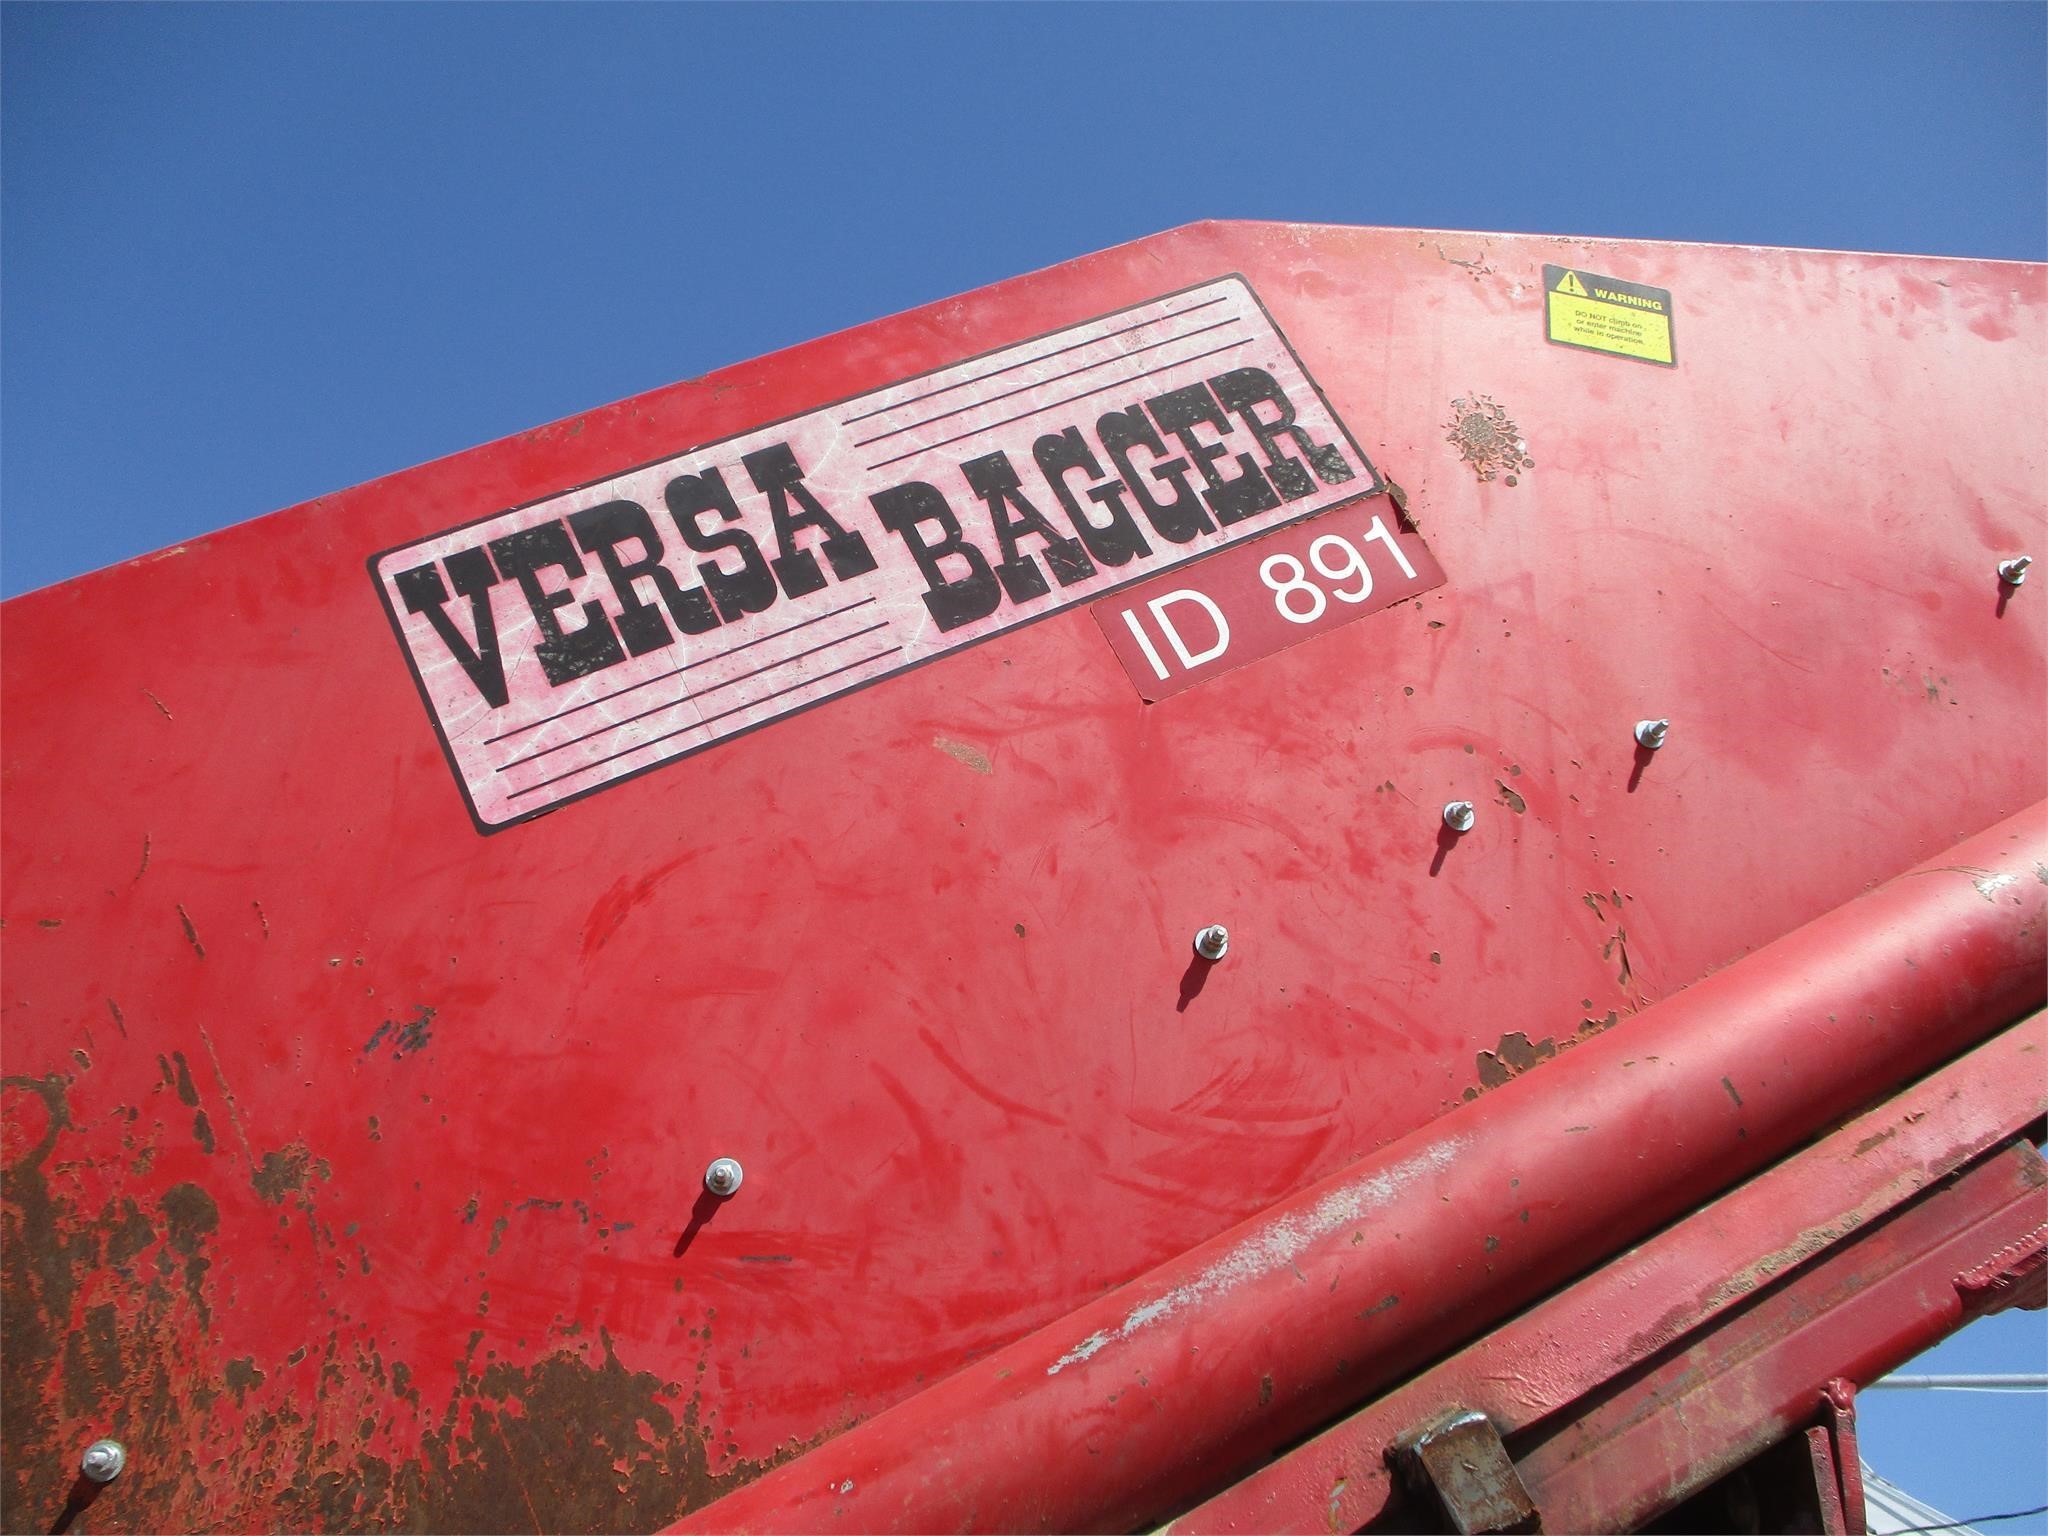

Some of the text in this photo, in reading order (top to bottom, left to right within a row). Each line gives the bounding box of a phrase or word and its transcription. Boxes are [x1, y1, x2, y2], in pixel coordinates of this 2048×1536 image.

[1594, 288, 1662, 310] WARNING
[1575, 310, 1588, 318] DO
[1589, 313, 1606, 321] NOT
[1609, 317, 1630, 327] climb
[1574, 326, 1595, 335] while
[1609, 326, 1642, 336] machine
[394, 367, 1355, 710] VERSA BAGGER
[1121, 515, 1418, 681] ID 891
